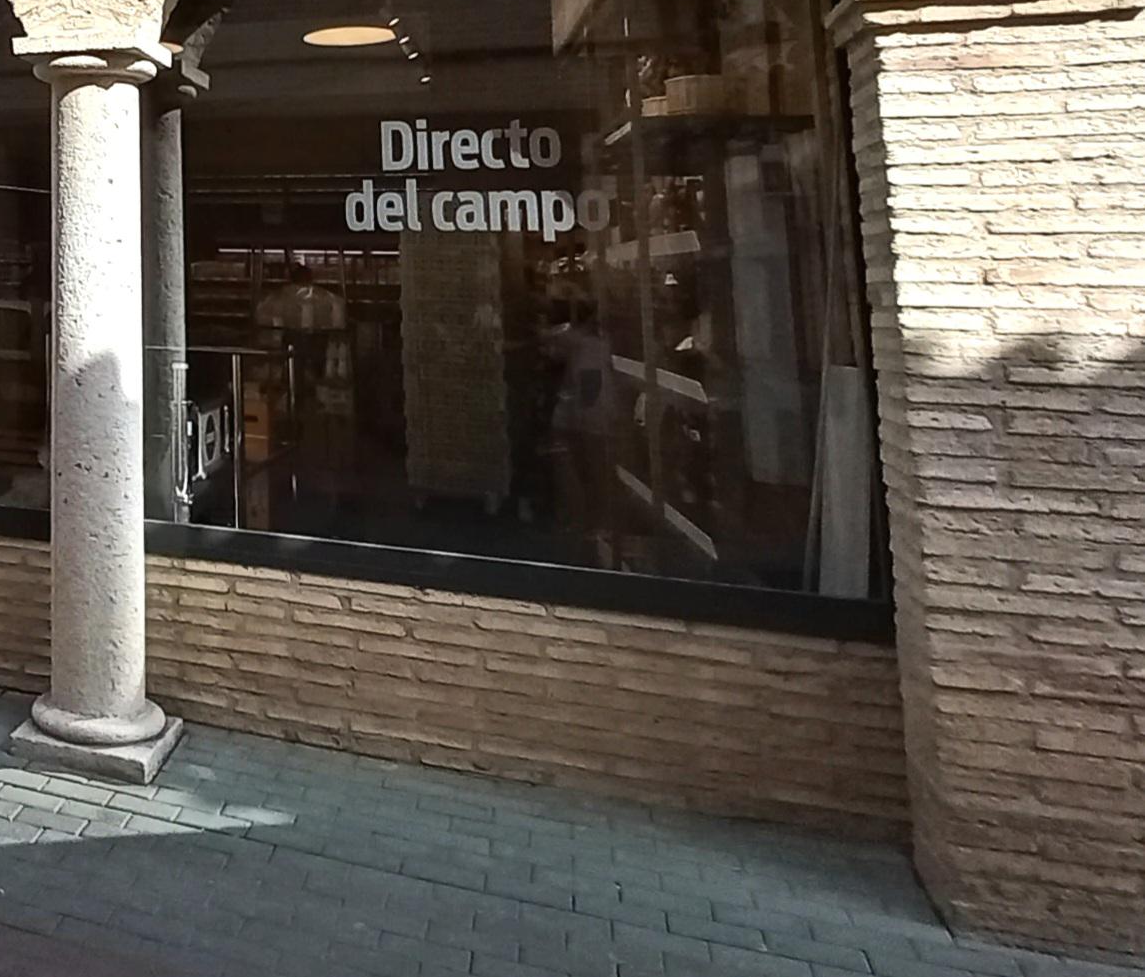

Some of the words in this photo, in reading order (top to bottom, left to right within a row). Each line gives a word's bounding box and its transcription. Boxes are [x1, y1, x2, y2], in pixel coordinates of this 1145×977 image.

[380, 118, 562, 172] Directo
[345, 178, 422, 233] del
[431, 188, 611, 243] campo
